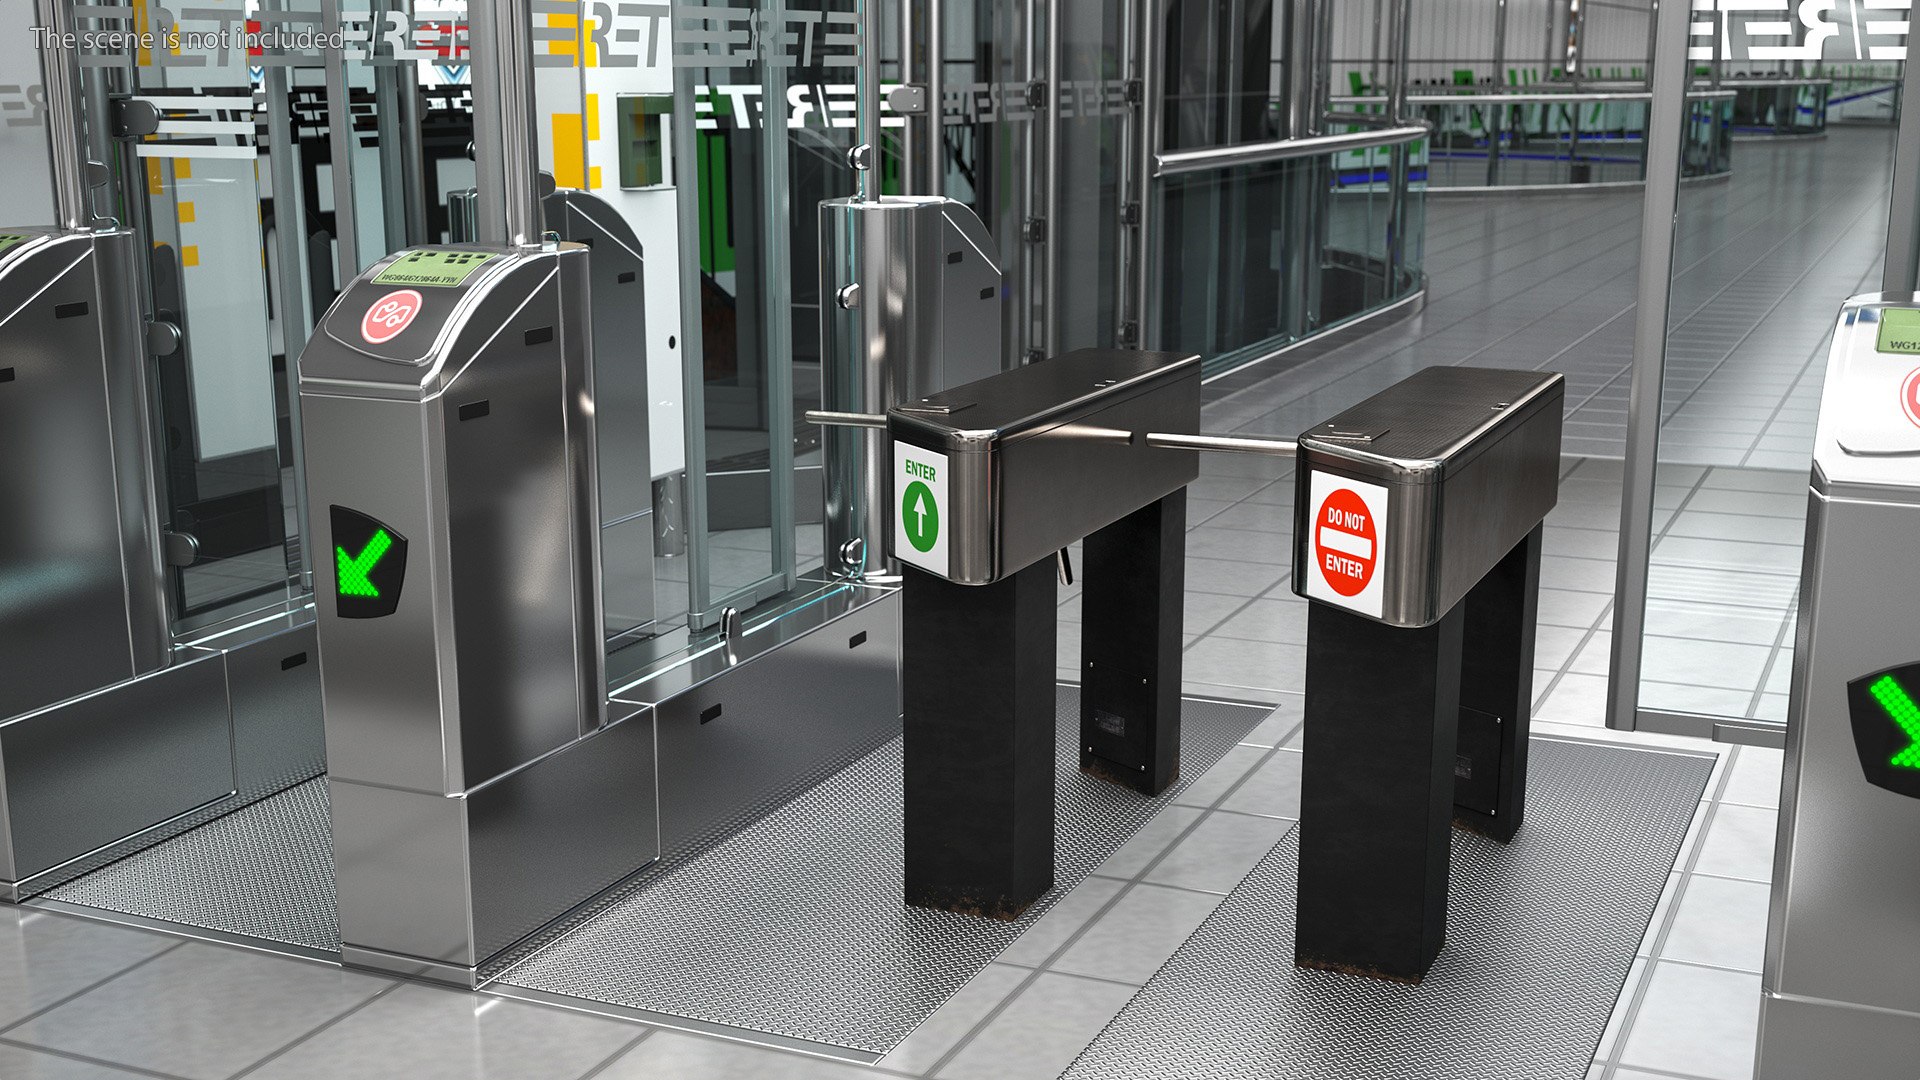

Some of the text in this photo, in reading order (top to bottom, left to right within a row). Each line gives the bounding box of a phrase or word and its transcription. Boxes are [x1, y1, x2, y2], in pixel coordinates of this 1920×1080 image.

[905, 459, 936, 482] ENTER
[1327, 507, 1365, 532] DO NOT
[1325, 553, 1363, 579] ENTER
